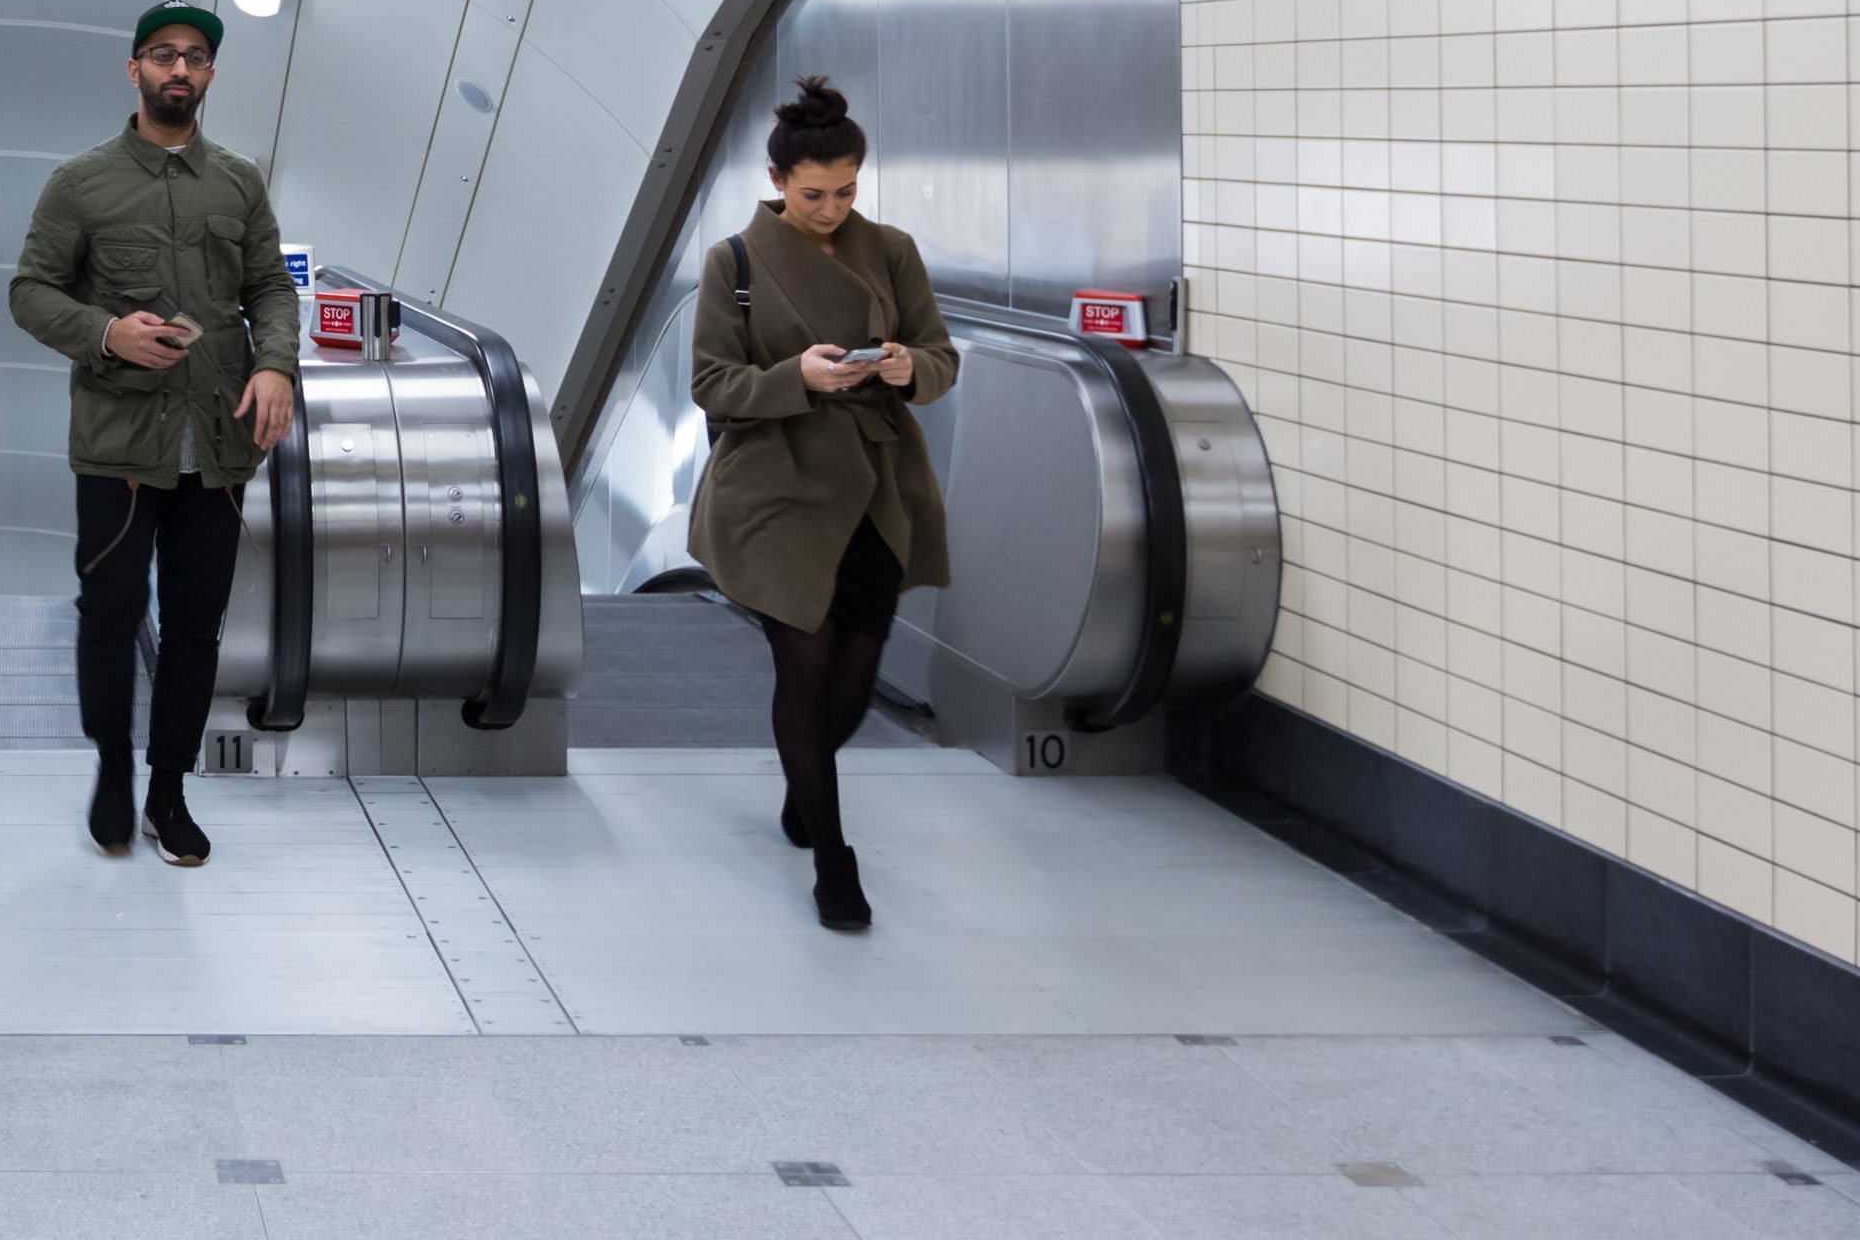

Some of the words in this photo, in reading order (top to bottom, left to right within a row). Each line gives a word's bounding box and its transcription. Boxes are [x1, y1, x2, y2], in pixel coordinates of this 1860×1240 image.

[290, 260, 307, 268] right
[323, 307, 350, 320] STOP
[1085, 305, 1120, 319] STOP
[216, 734, 241, 769] 11
[1025, 734, 1065, 769] 10
